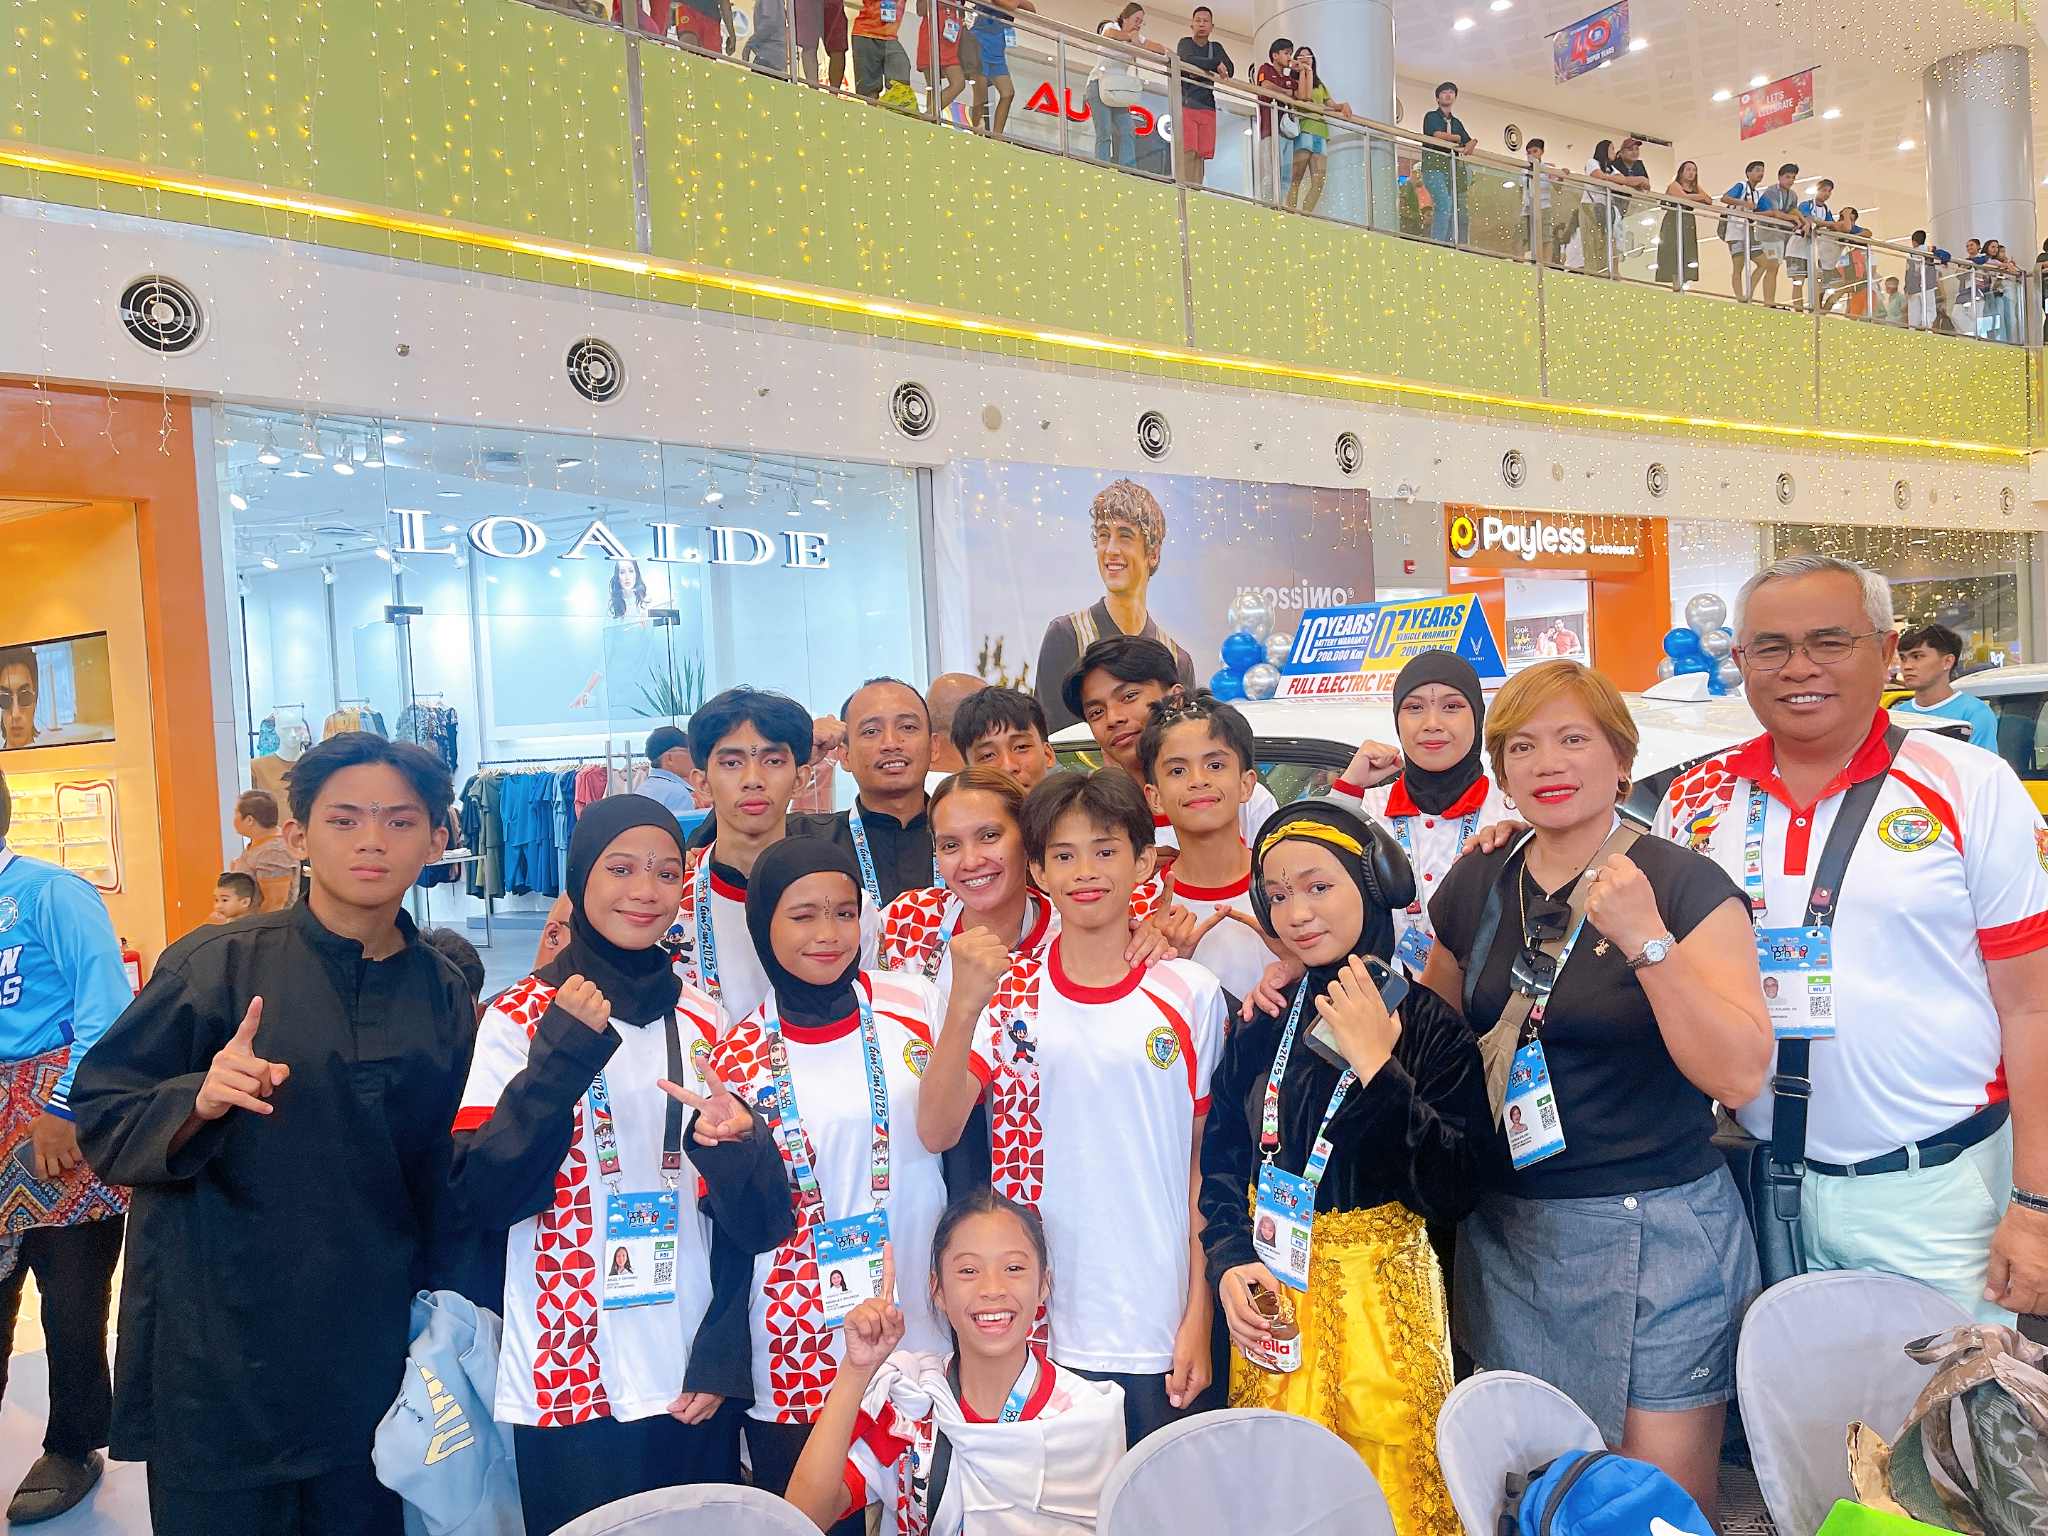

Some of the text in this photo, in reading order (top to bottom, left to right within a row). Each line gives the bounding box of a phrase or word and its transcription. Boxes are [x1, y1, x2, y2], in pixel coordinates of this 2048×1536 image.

[388, 508, 830, 569] LOALDE
[1481, 517, 1586, 561] Payless
[1410, 604, 1466, 629] YEARS
[1291, 613, 1376, 664] 10 YEARS
[1338, 635, 1369, 645] WARRANTY
[1396, 629, 1457, 641] VEHICLE WARRANTY
[1287, 677, 1316, 695] FULL
[1316, 673, 1377, 695] ELECTRIC
